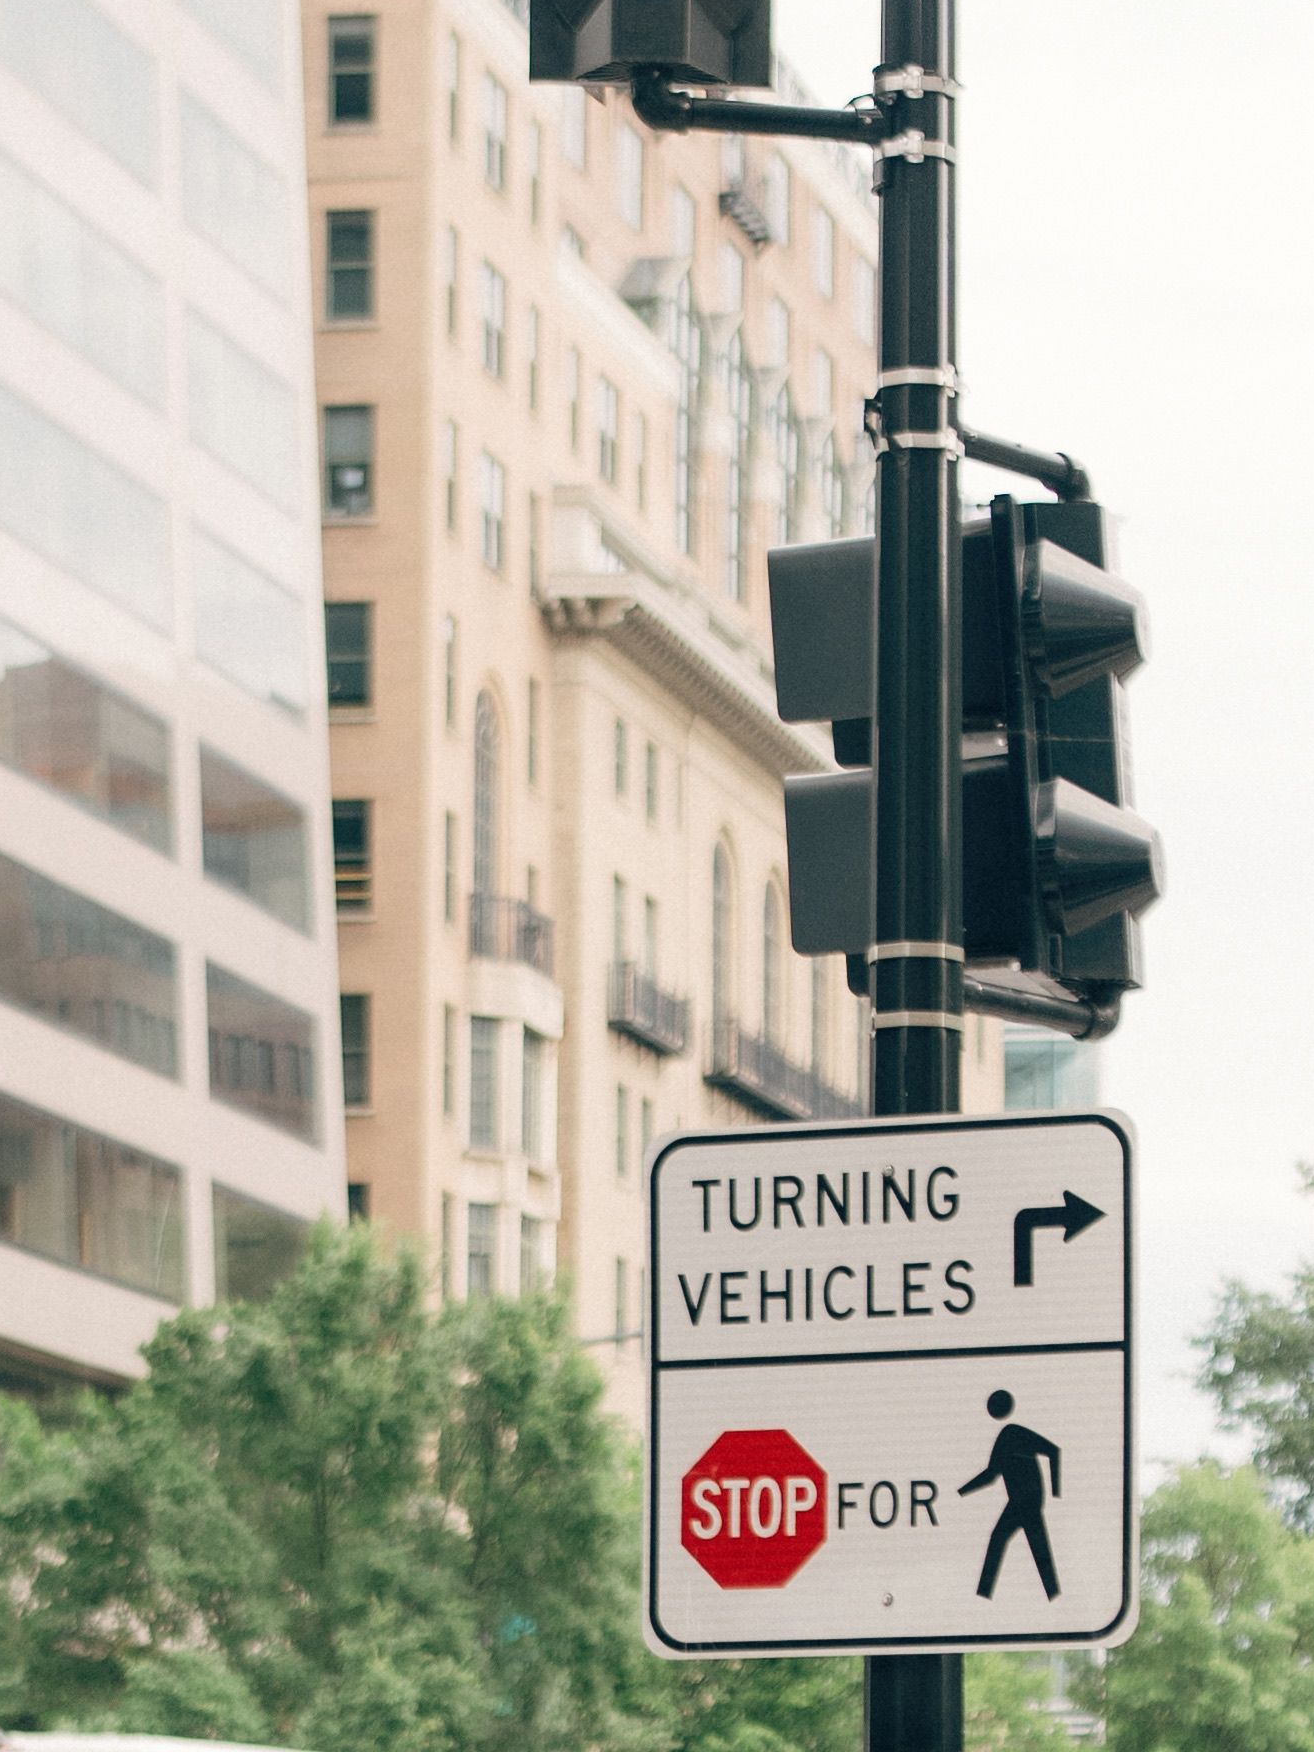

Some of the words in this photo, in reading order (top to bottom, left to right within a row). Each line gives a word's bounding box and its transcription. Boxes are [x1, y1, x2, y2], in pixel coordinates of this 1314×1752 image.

[691, 1166, 961, 1233] TURNING
[677, 1259, 977, 1326] VEHICLES
[689, 1475, 819, 1541] STOP
[837, 1479, 940, 1530] FOR
